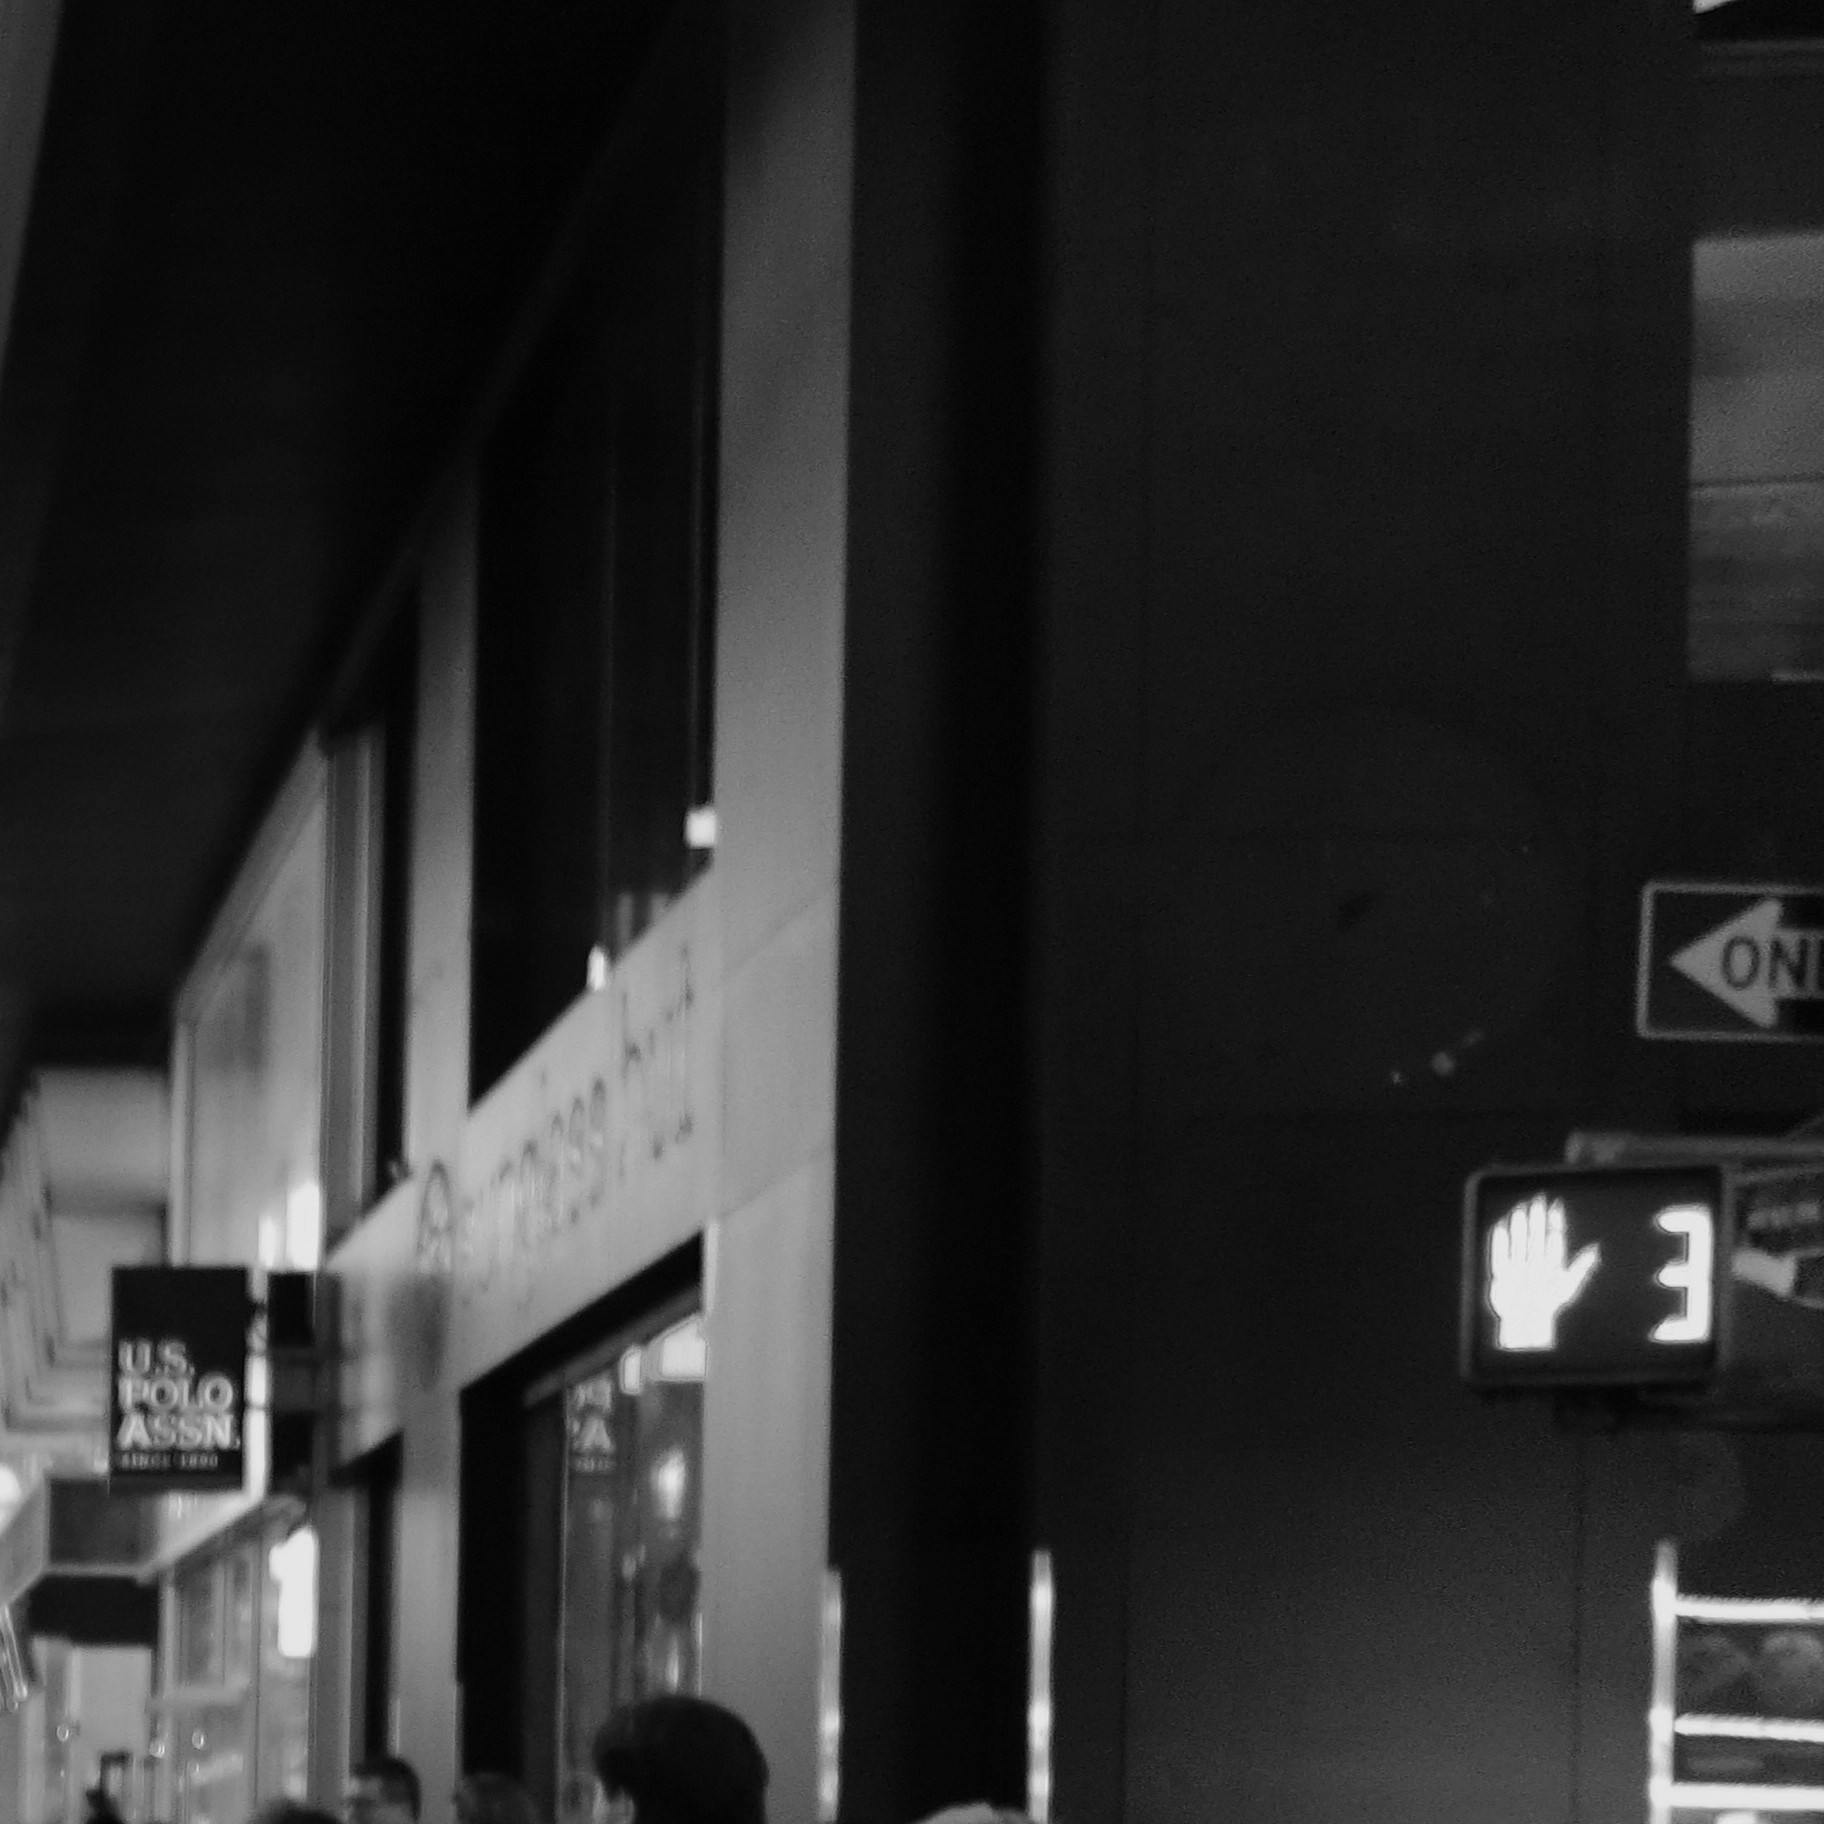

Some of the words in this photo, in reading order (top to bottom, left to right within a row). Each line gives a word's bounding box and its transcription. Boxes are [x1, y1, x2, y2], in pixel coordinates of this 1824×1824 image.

[1721, 935, 1824, 992] ON
[1648, 1203, 1714, 1344] 3
[118, 1339, 195, 1376] U.S.
[118, 1374, 234, 1411] POLO
[117, 1413, 241, 1450] ASSN.
